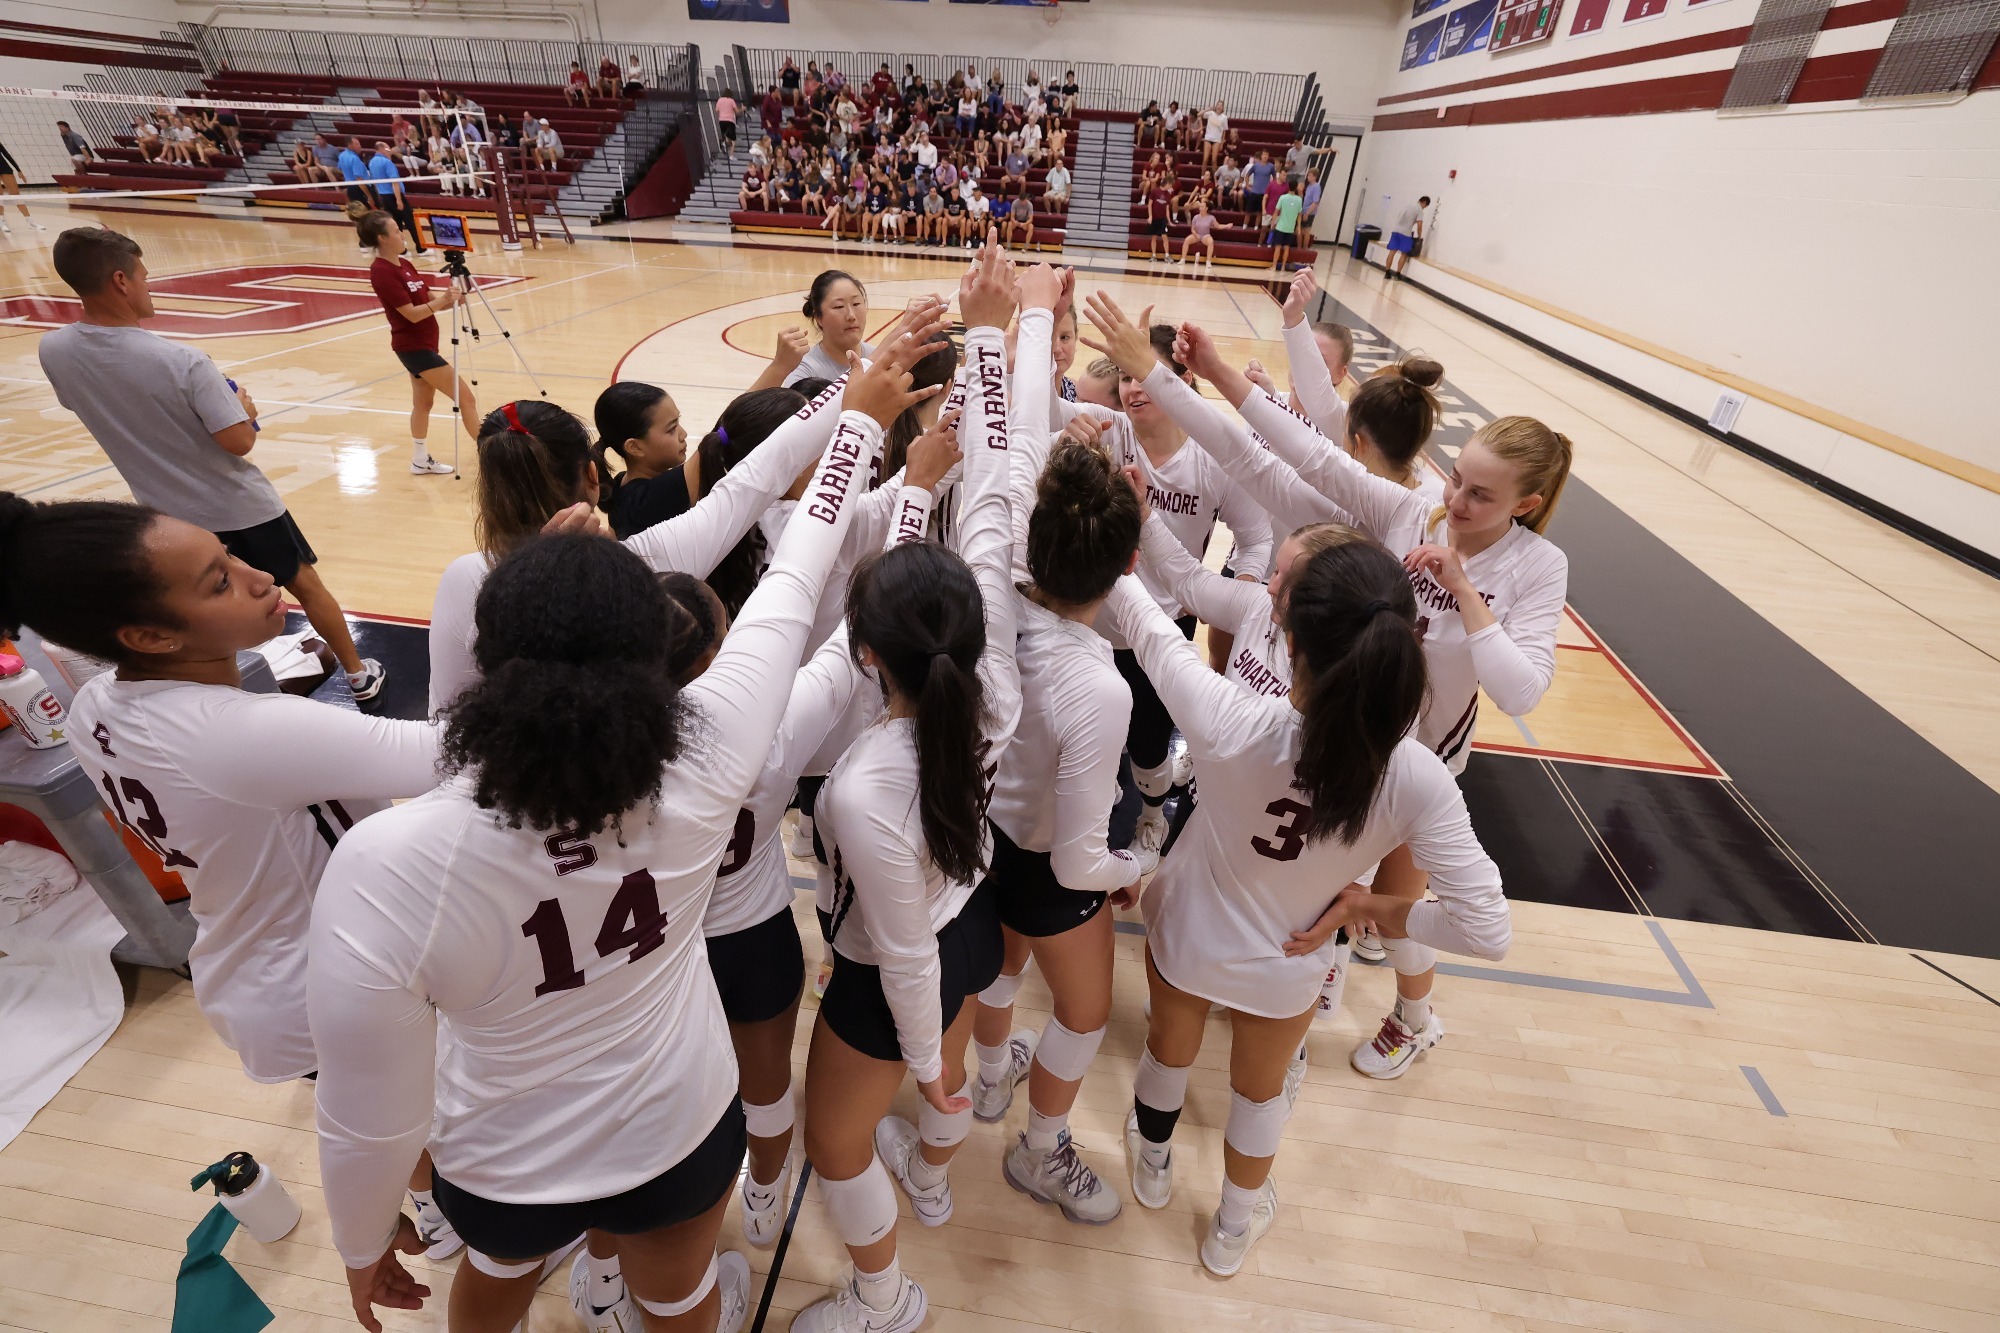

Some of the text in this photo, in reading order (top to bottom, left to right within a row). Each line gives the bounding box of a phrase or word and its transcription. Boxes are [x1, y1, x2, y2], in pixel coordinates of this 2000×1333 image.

[75, 91, 176, 105] SWARTHMORE GARNET
[795, 370, 851, 421] GARN
[978, 346, 1008, 451] GARNET
[808, 423, 865, 525] GARNET
[544, 829, 598, 877] S
[1250, 797, 1313, 862] 3
[521, 867, 669, 998] 14
